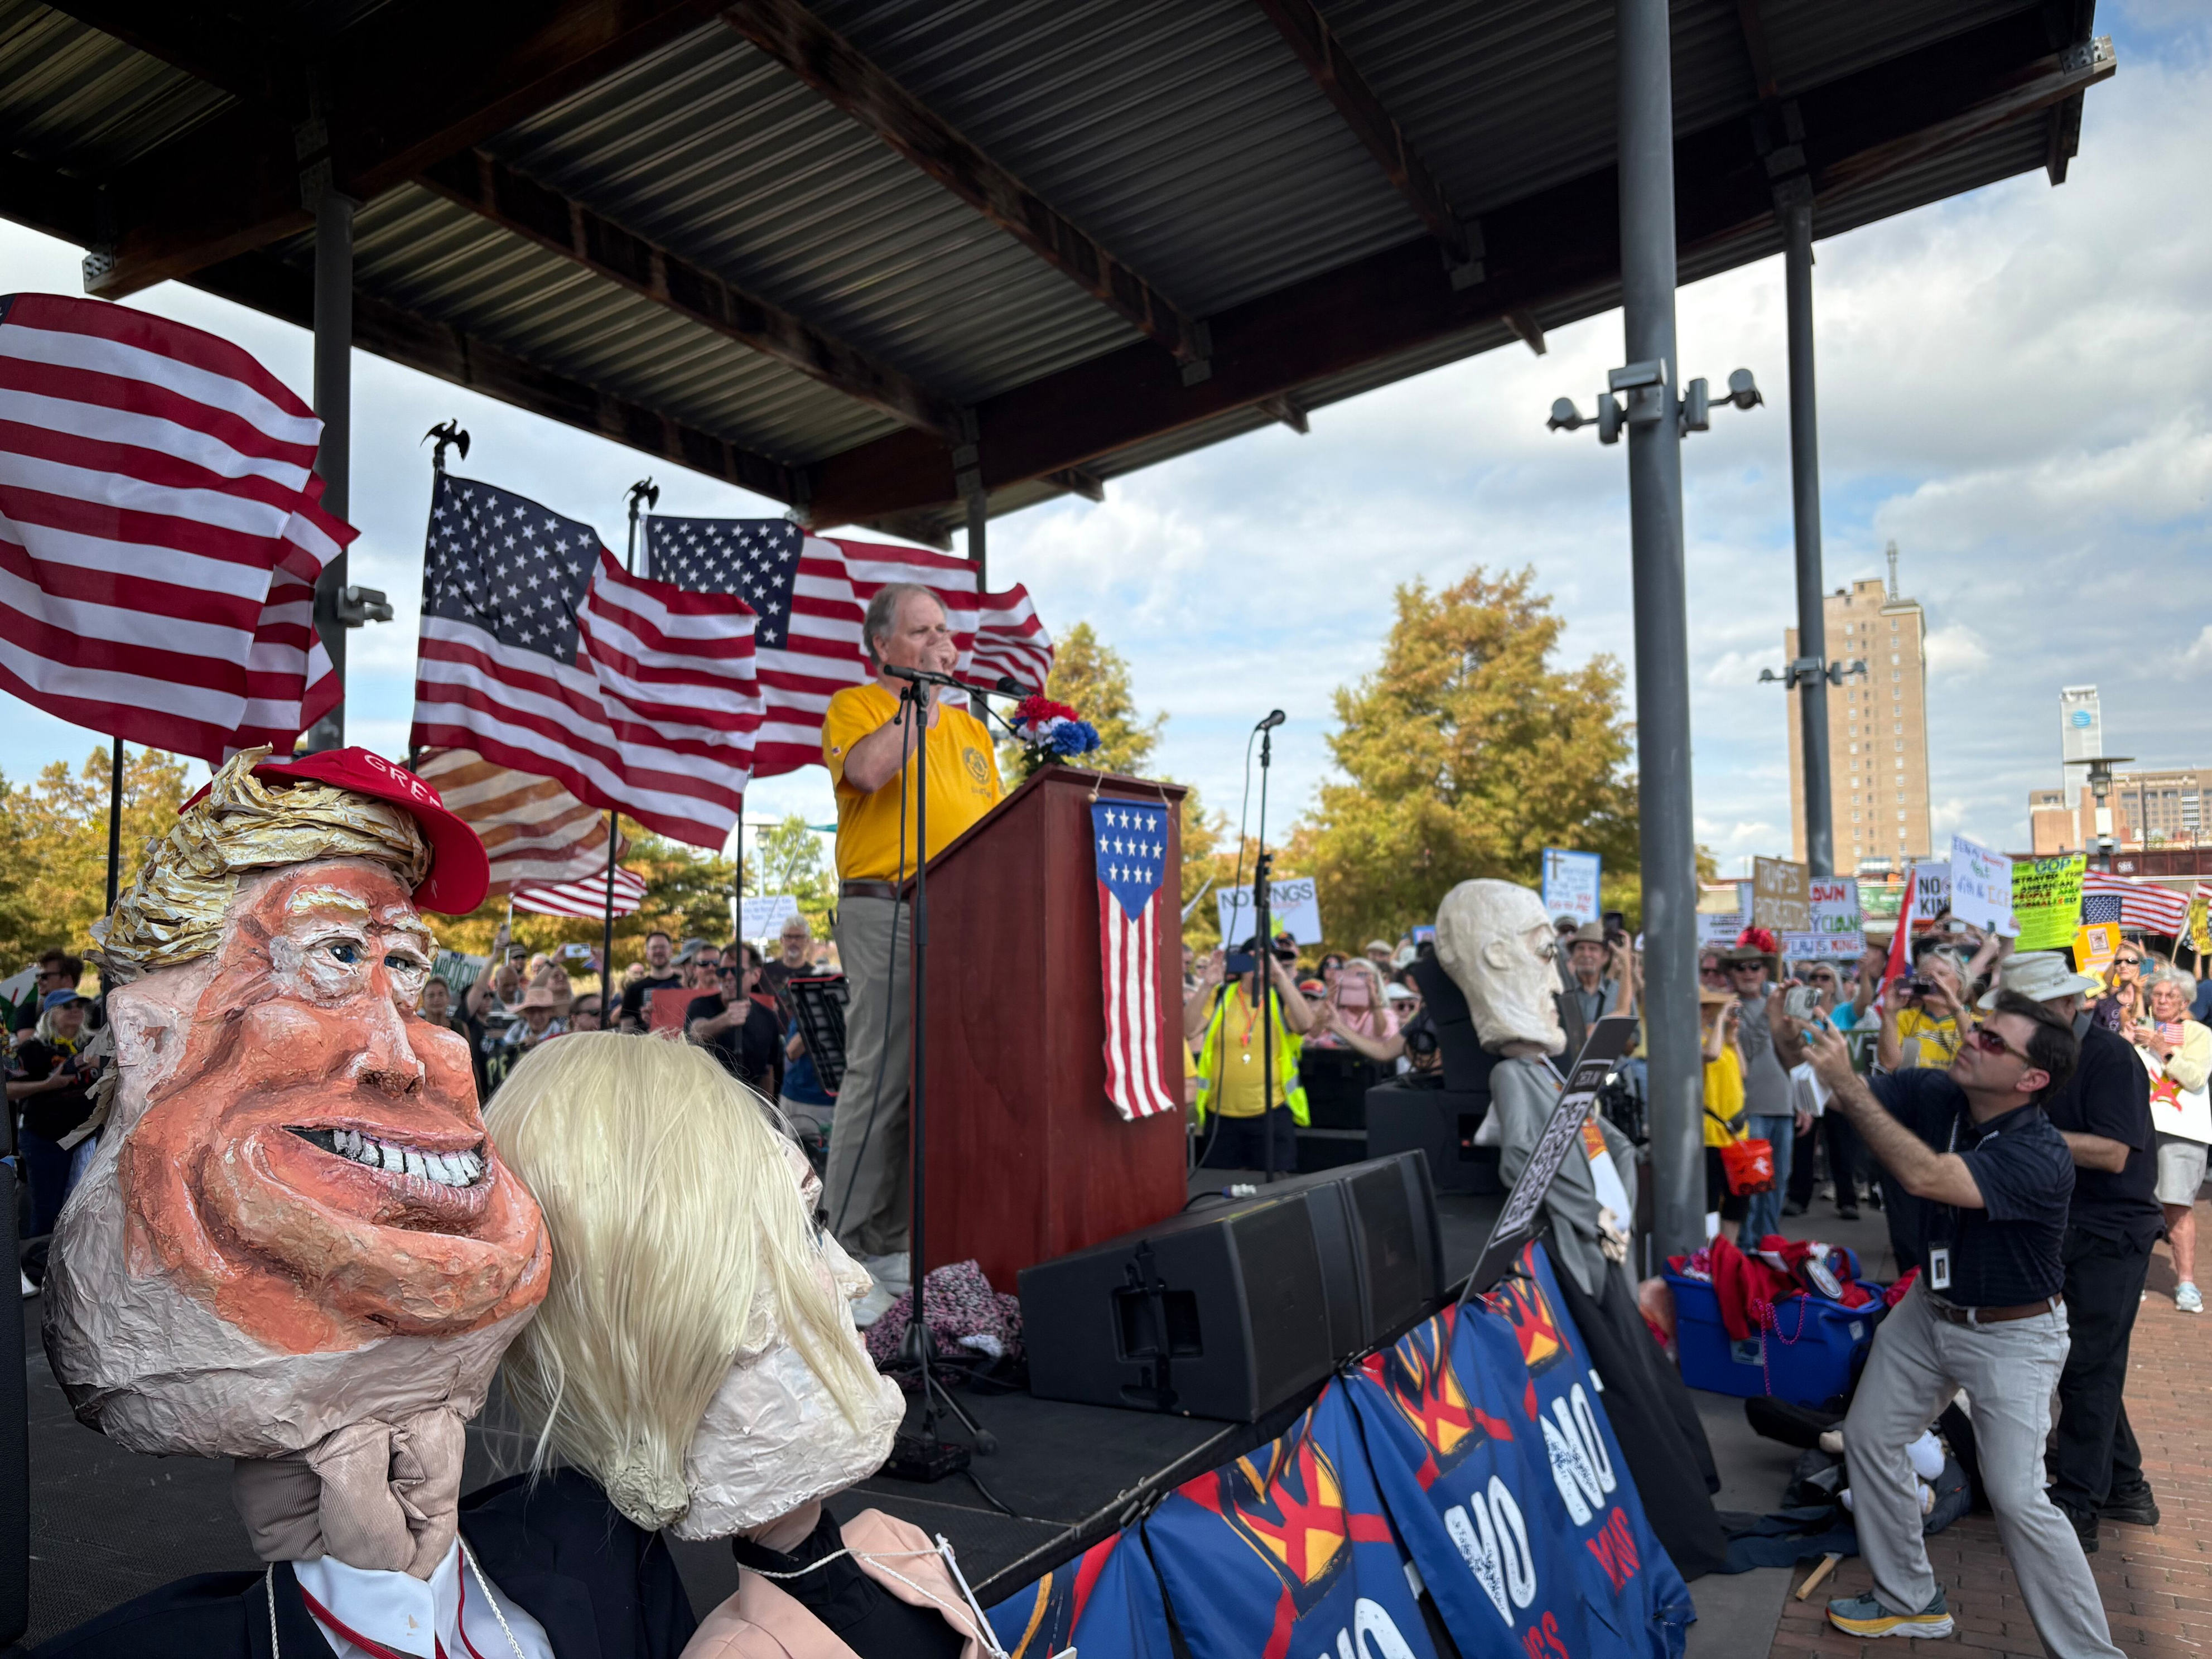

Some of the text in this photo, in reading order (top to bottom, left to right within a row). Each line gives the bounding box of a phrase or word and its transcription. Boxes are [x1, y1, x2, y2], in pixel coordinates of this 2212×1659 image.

[2035, 857, 2071, 875] GOP
[1919, 876, 1940, 895] NO
[1221, 890, 1250, 910] NO
[1920, 897, 1951, 917] KIN
[1539, 1382, 1617, 1527] NO
[1444, 1474, 1537, 1628] NO
